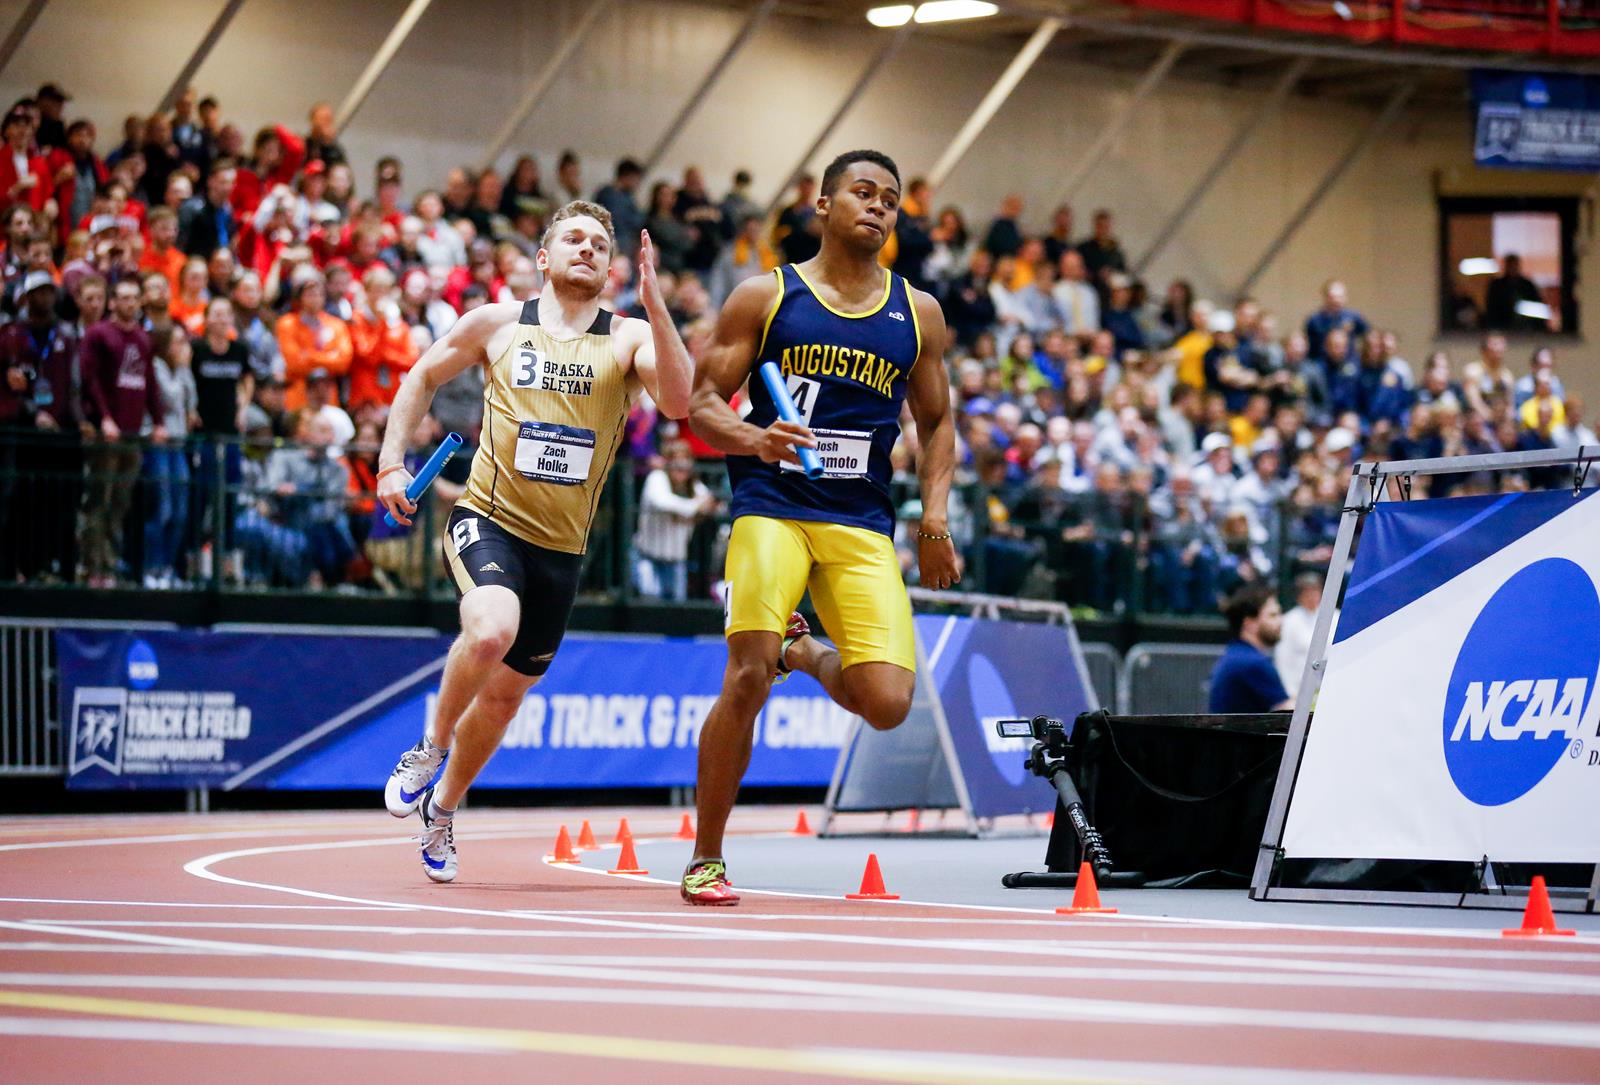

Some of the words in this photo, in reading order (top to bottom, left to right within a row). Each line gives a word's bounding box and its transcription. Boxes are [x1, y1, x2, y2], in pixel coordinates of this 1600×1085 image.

[516, 351, 538, 386] 3
[543, 361, 595, 378] BRASKA
[781, 344, 900, 399] AUGUSTANA
[541, 376, 592, 396] SLEYAN
[543, 445, 567, 458] Zach
[816, 441, 839, 452] Josh
[537, 457, 569, 473] Holka
[454, 520, 472, 549] 3
[126, 705, 184, 738] TRACK
[200, 706, 251, 739] FIELD
[549, 693, 649, 750] TRACK
[1450, 677, 1588, 742] NCAA
